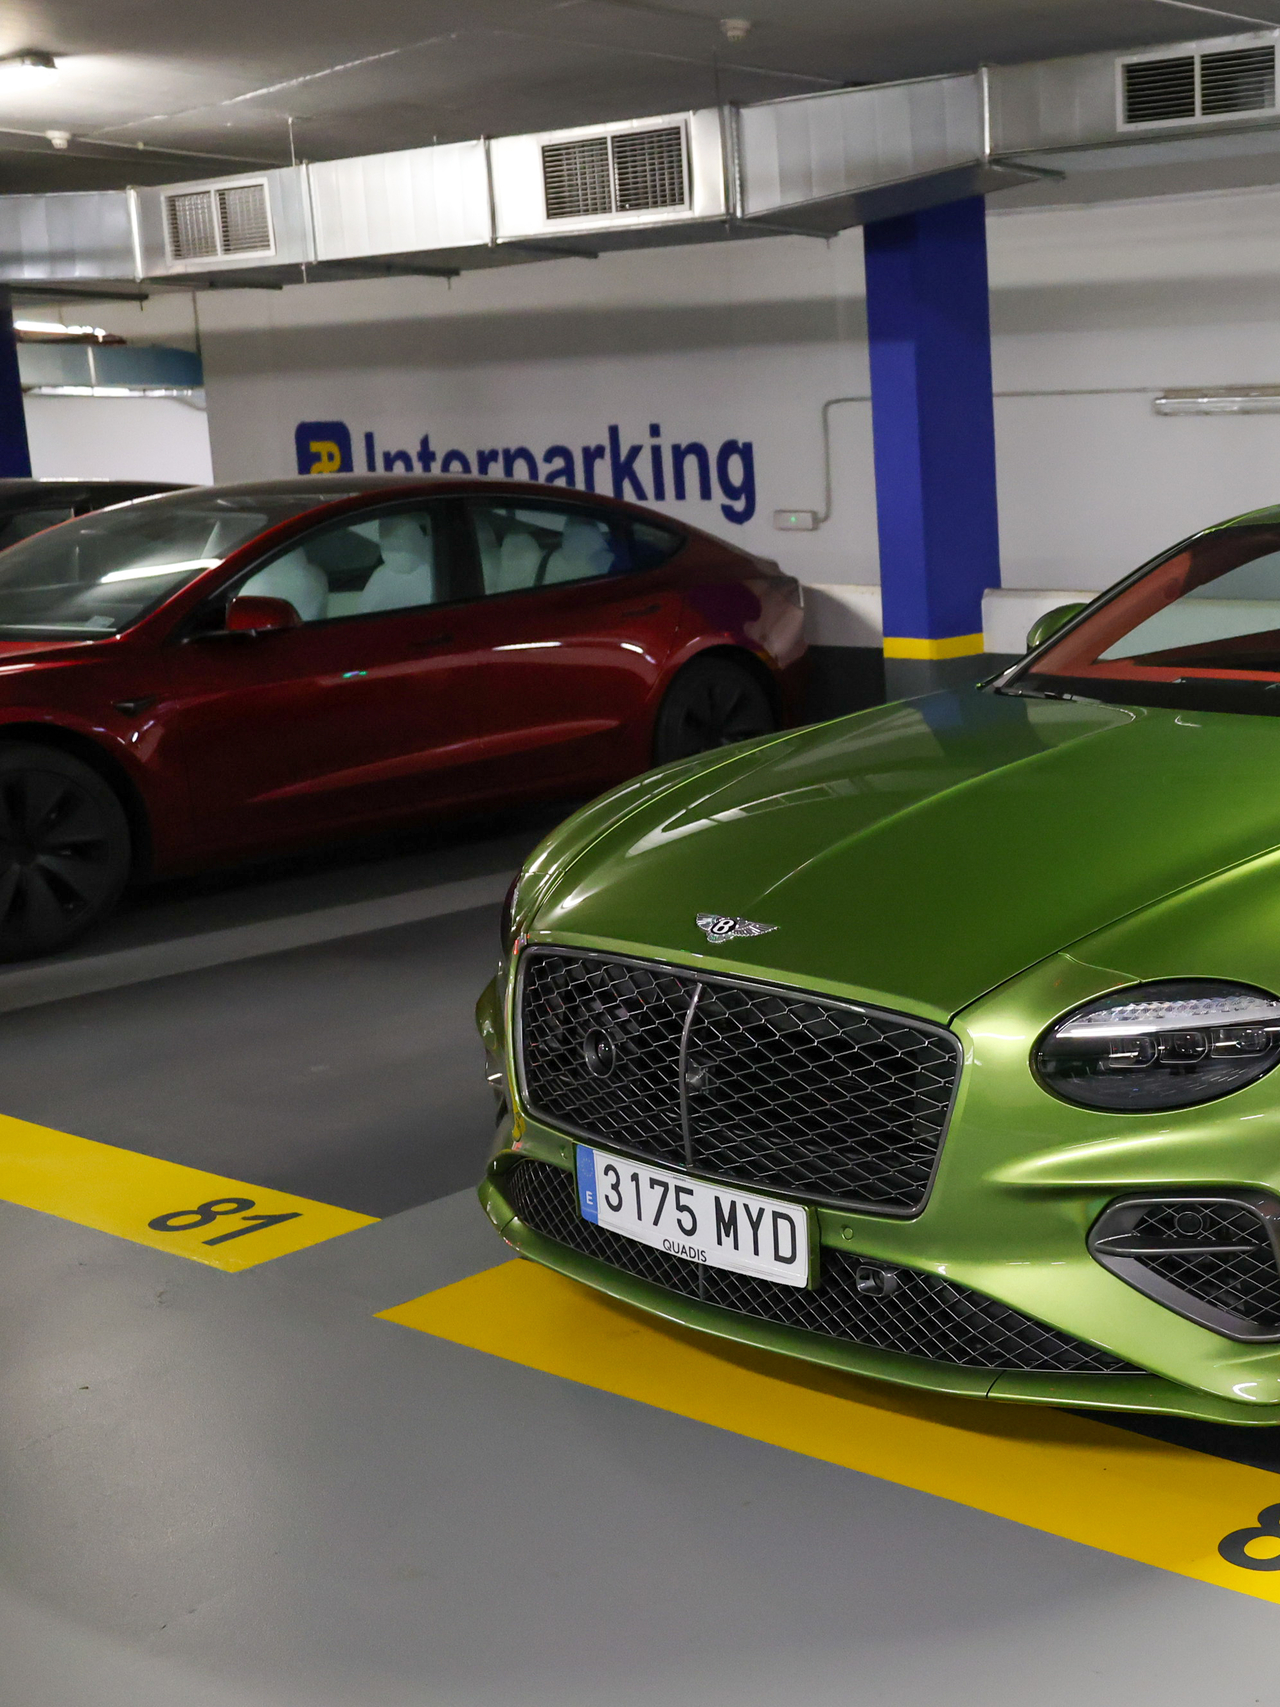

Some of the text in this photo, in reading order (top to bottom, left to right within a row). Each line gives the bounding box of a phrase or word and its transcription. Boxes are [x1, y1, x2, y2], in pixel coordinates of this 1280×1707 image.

[586, 1190, 594, 1205] E
[603, 1163, 797, 1265] 3175 MYD
[147, 1197, 303, 1247] 81
[662, 1238, 707, 1263] QUADIS
